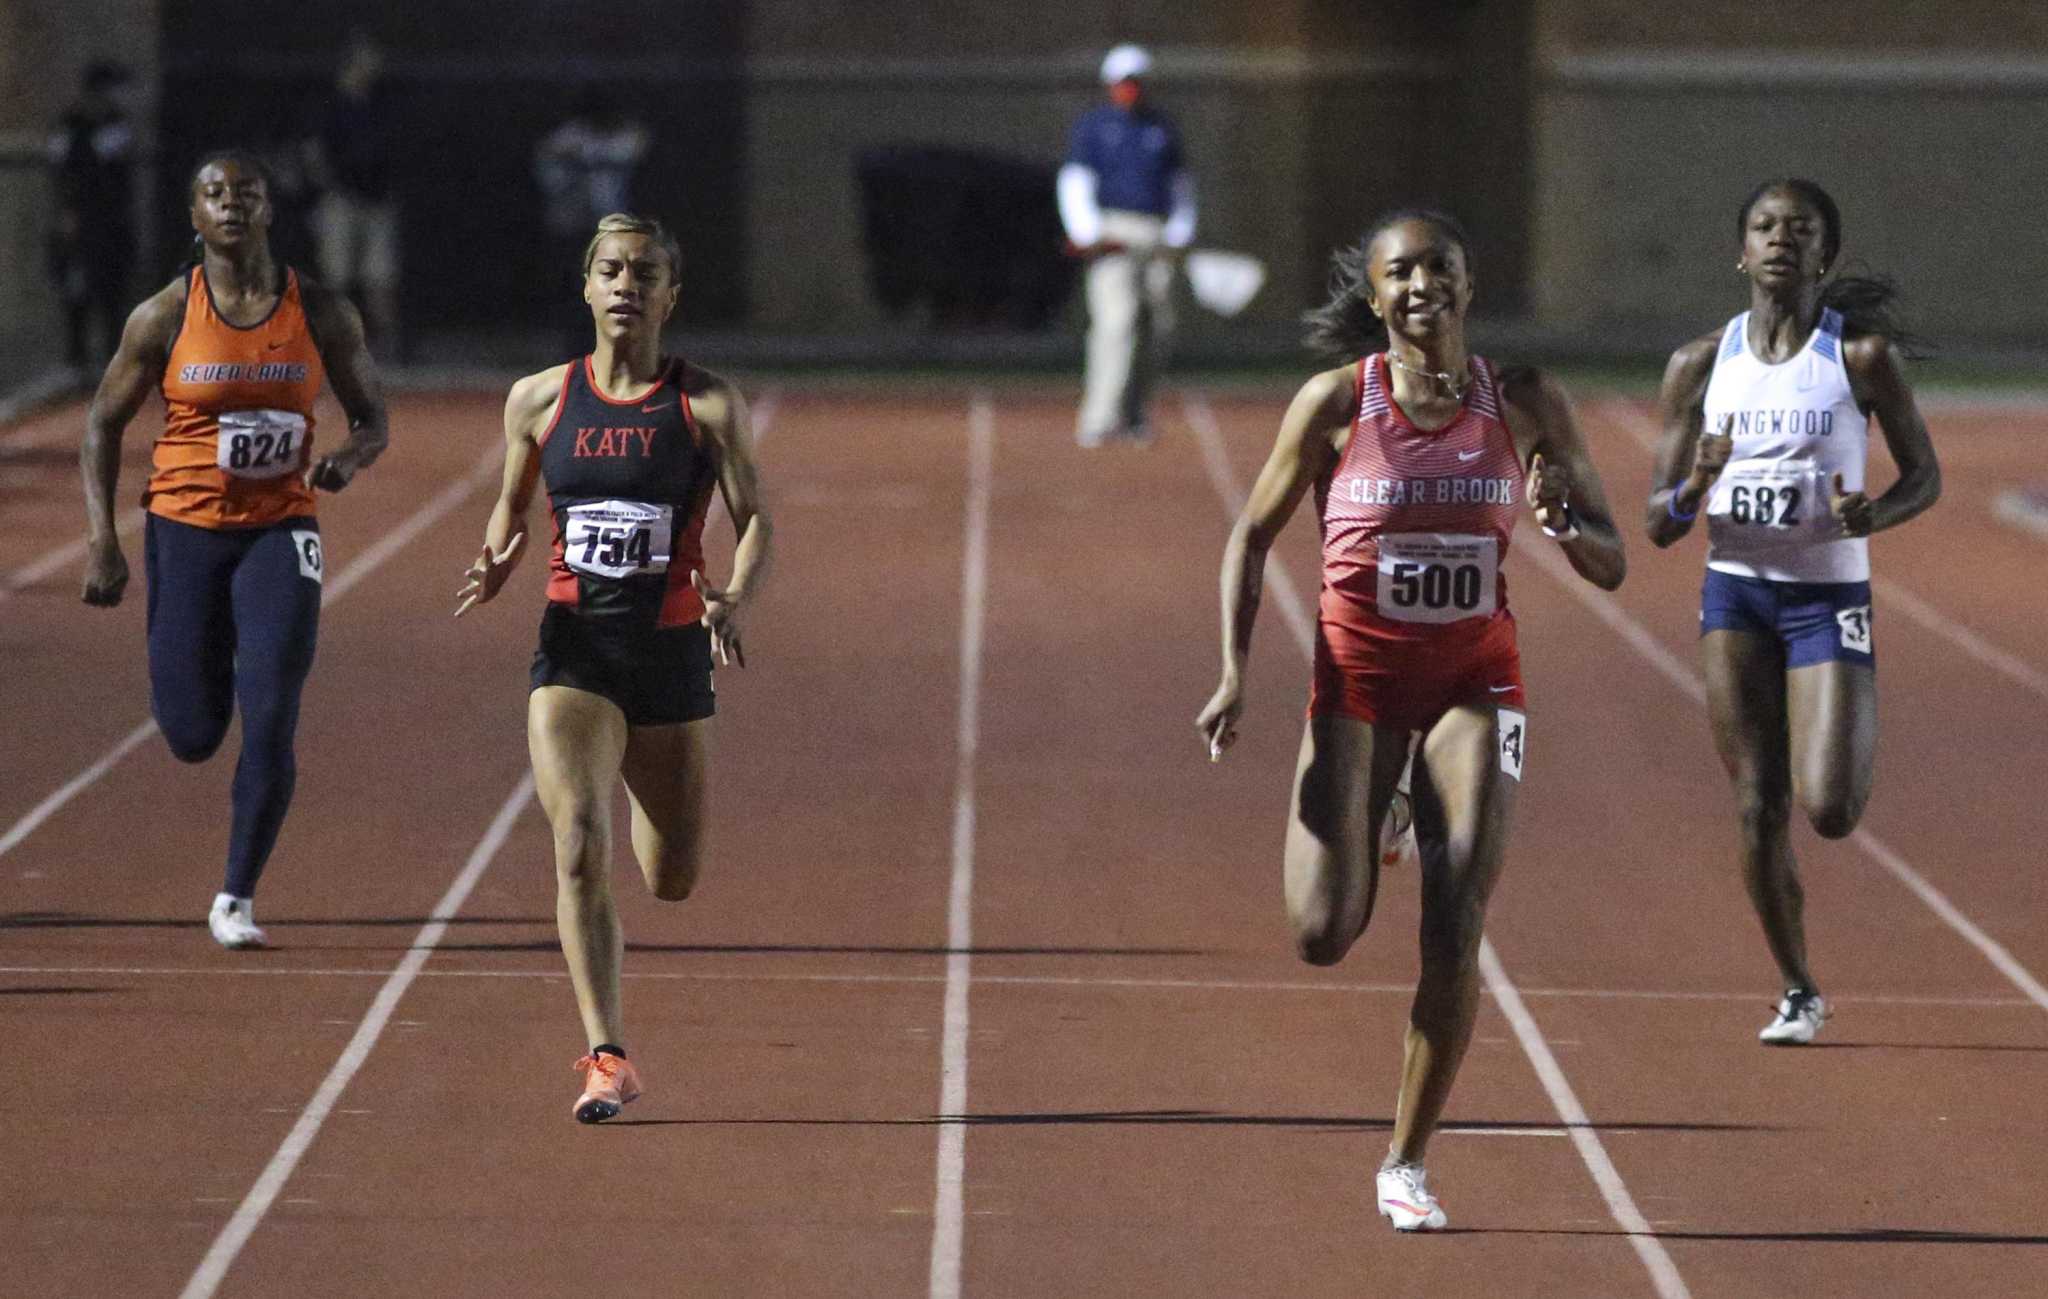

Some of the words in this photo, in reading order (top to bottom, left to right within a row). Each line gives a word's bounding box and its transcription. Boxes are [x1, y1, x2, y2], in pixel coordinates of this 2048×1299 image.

[180, 363, 241, 383] SEVEN
[244, 363, 307, 383] LAKES
[1717, 410, 1834, 436] KNGWOOD
[230, 431, 294, 469] 824
[573, 427, 657, 457] KATY
[1349, 479, 1425, 504] CLEAR
[1435, 479, 1512, 504] BROOK
[1731, 485, 1801, 526] 682
[582, 525, 651, 568] 754
[1391, 563, 1481, 610] 500
